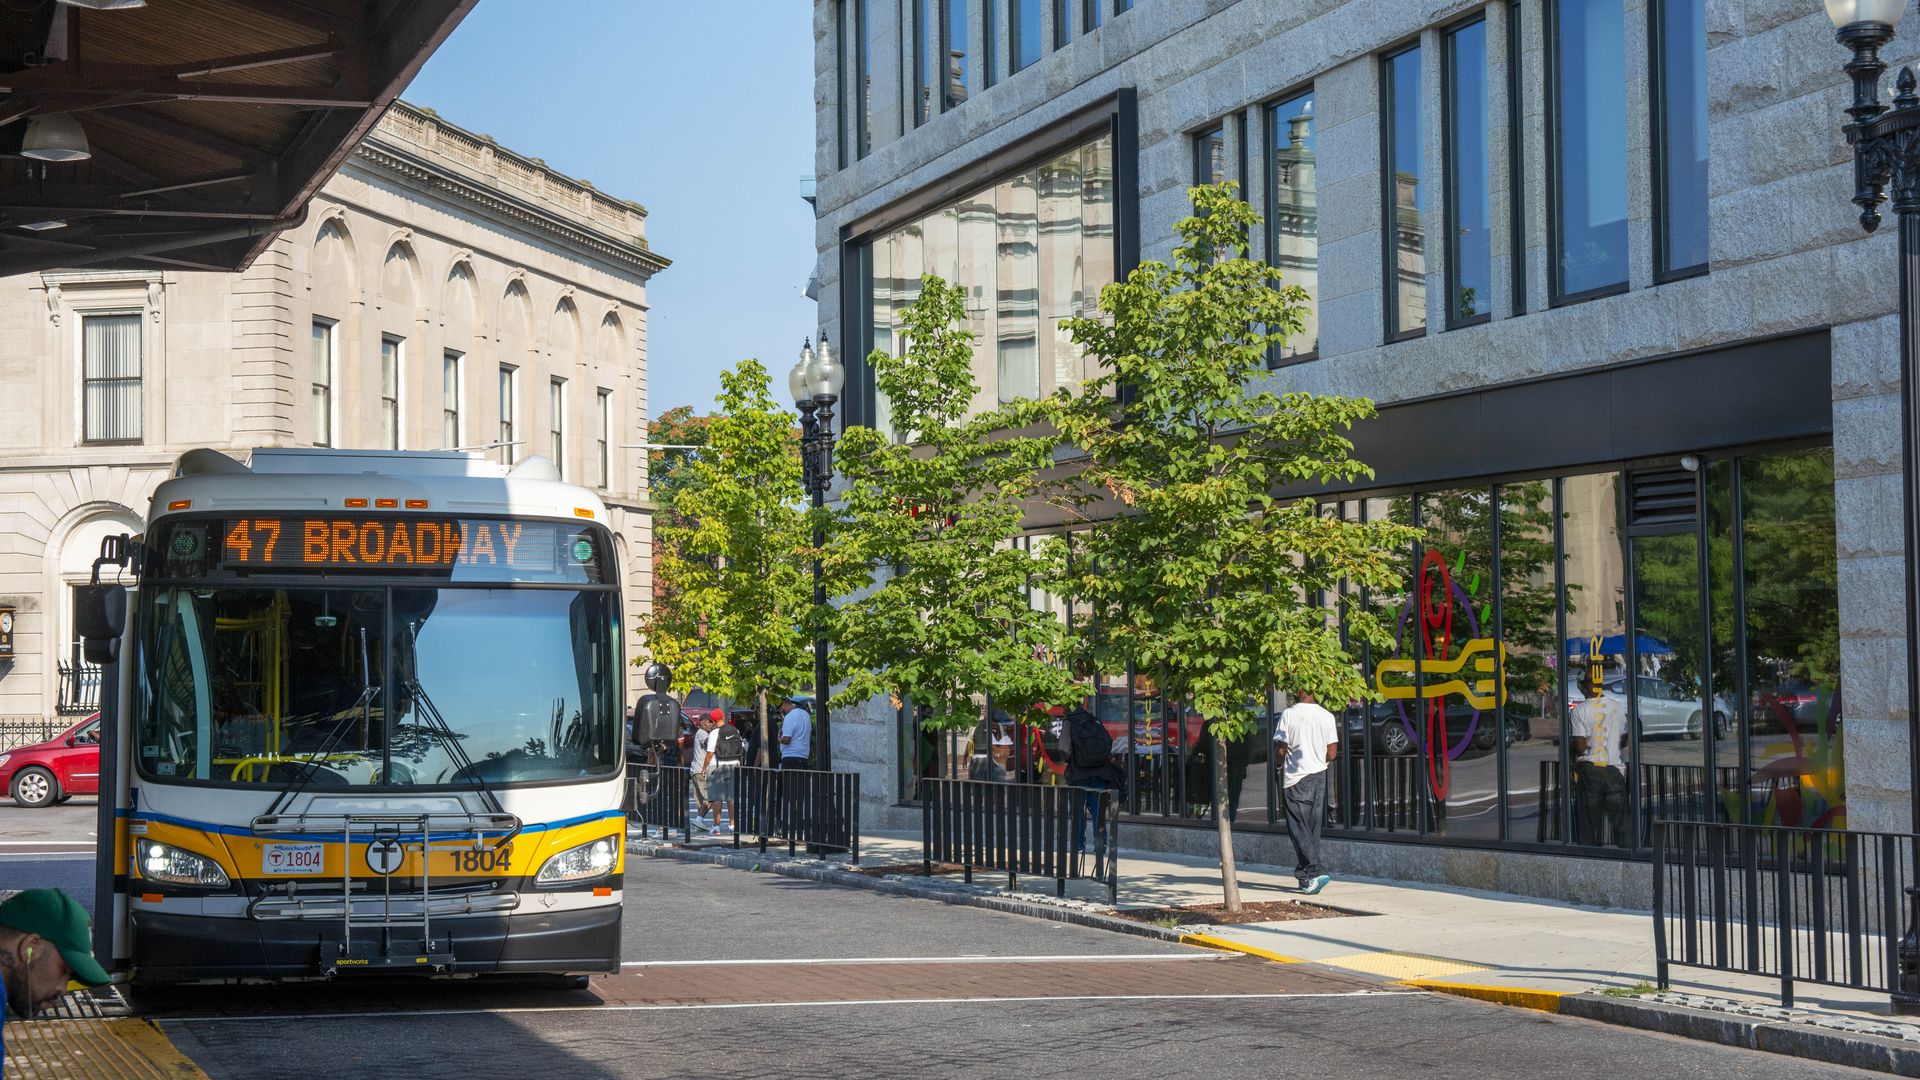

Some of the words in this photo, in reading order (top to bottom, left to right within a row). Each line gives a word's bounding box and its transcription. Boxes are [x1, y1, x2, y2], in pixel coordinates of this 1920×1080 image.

[226, 520, 280, 561] 47
[304, 520, 522, 564] BROADWAY
[1590, 635, 1607, 767] DINNER
[287, 851, 320, 867] 1804
[450, 848, 511, 872] 1804
